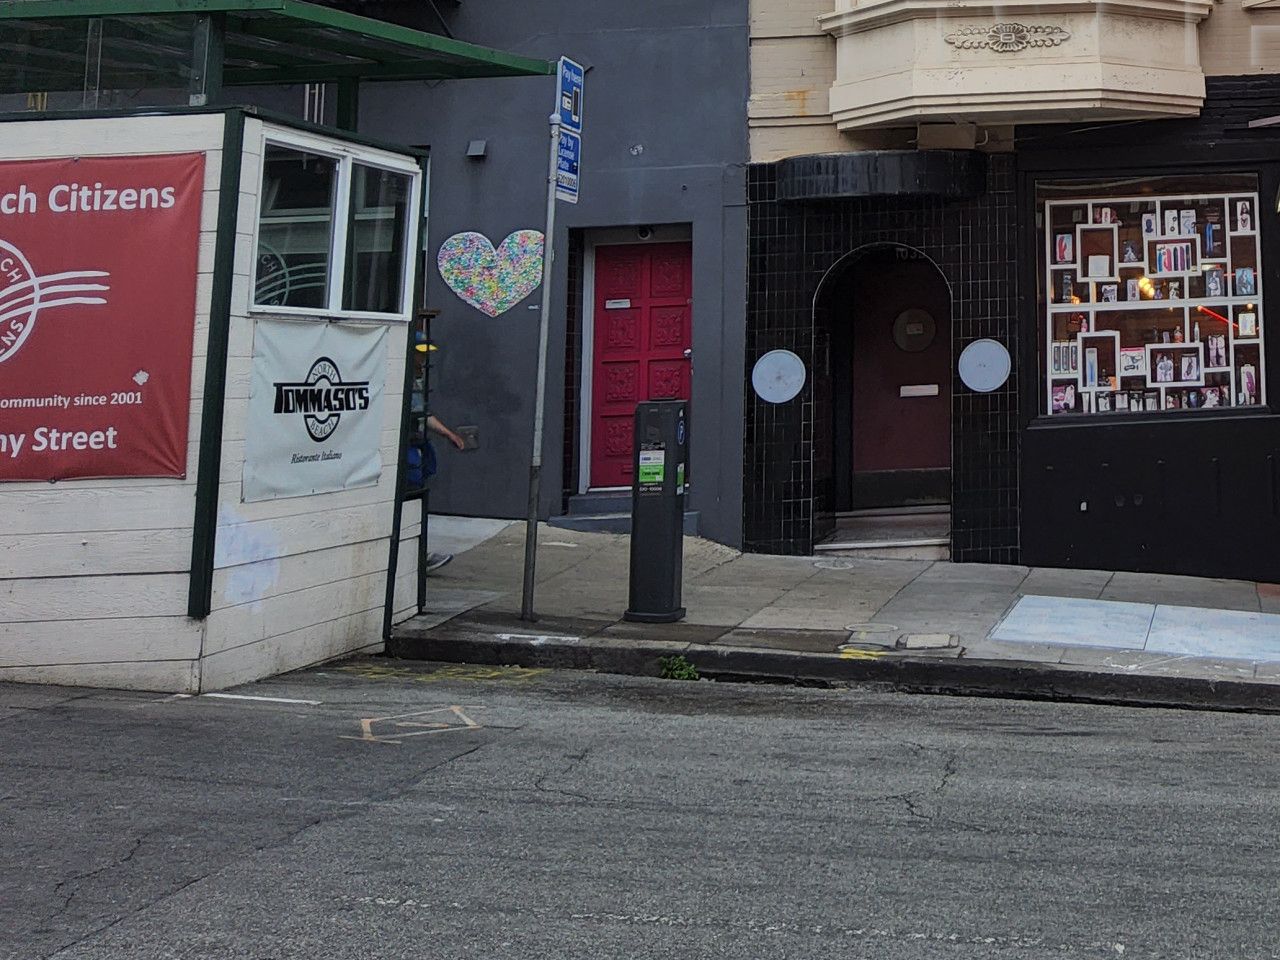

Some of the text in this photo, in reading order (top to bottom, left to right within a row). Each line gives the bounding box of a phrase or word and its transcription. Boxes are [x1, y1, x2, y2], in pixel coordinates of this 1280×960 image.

[562, 64, 571, 83] Pay
[48, 182, 176, 213] Citizens
[311, 362, 336, 381] NORTH
[73, 393, 108, 406] since
[110, 391, 143, 405] 2001
[272, 381, 370, 414] TOMMASO'S
[310, 418, 335, 437] BEACH
[31, 426, 118, 452] Street
[290, 452, 321, 464] Ristorante
